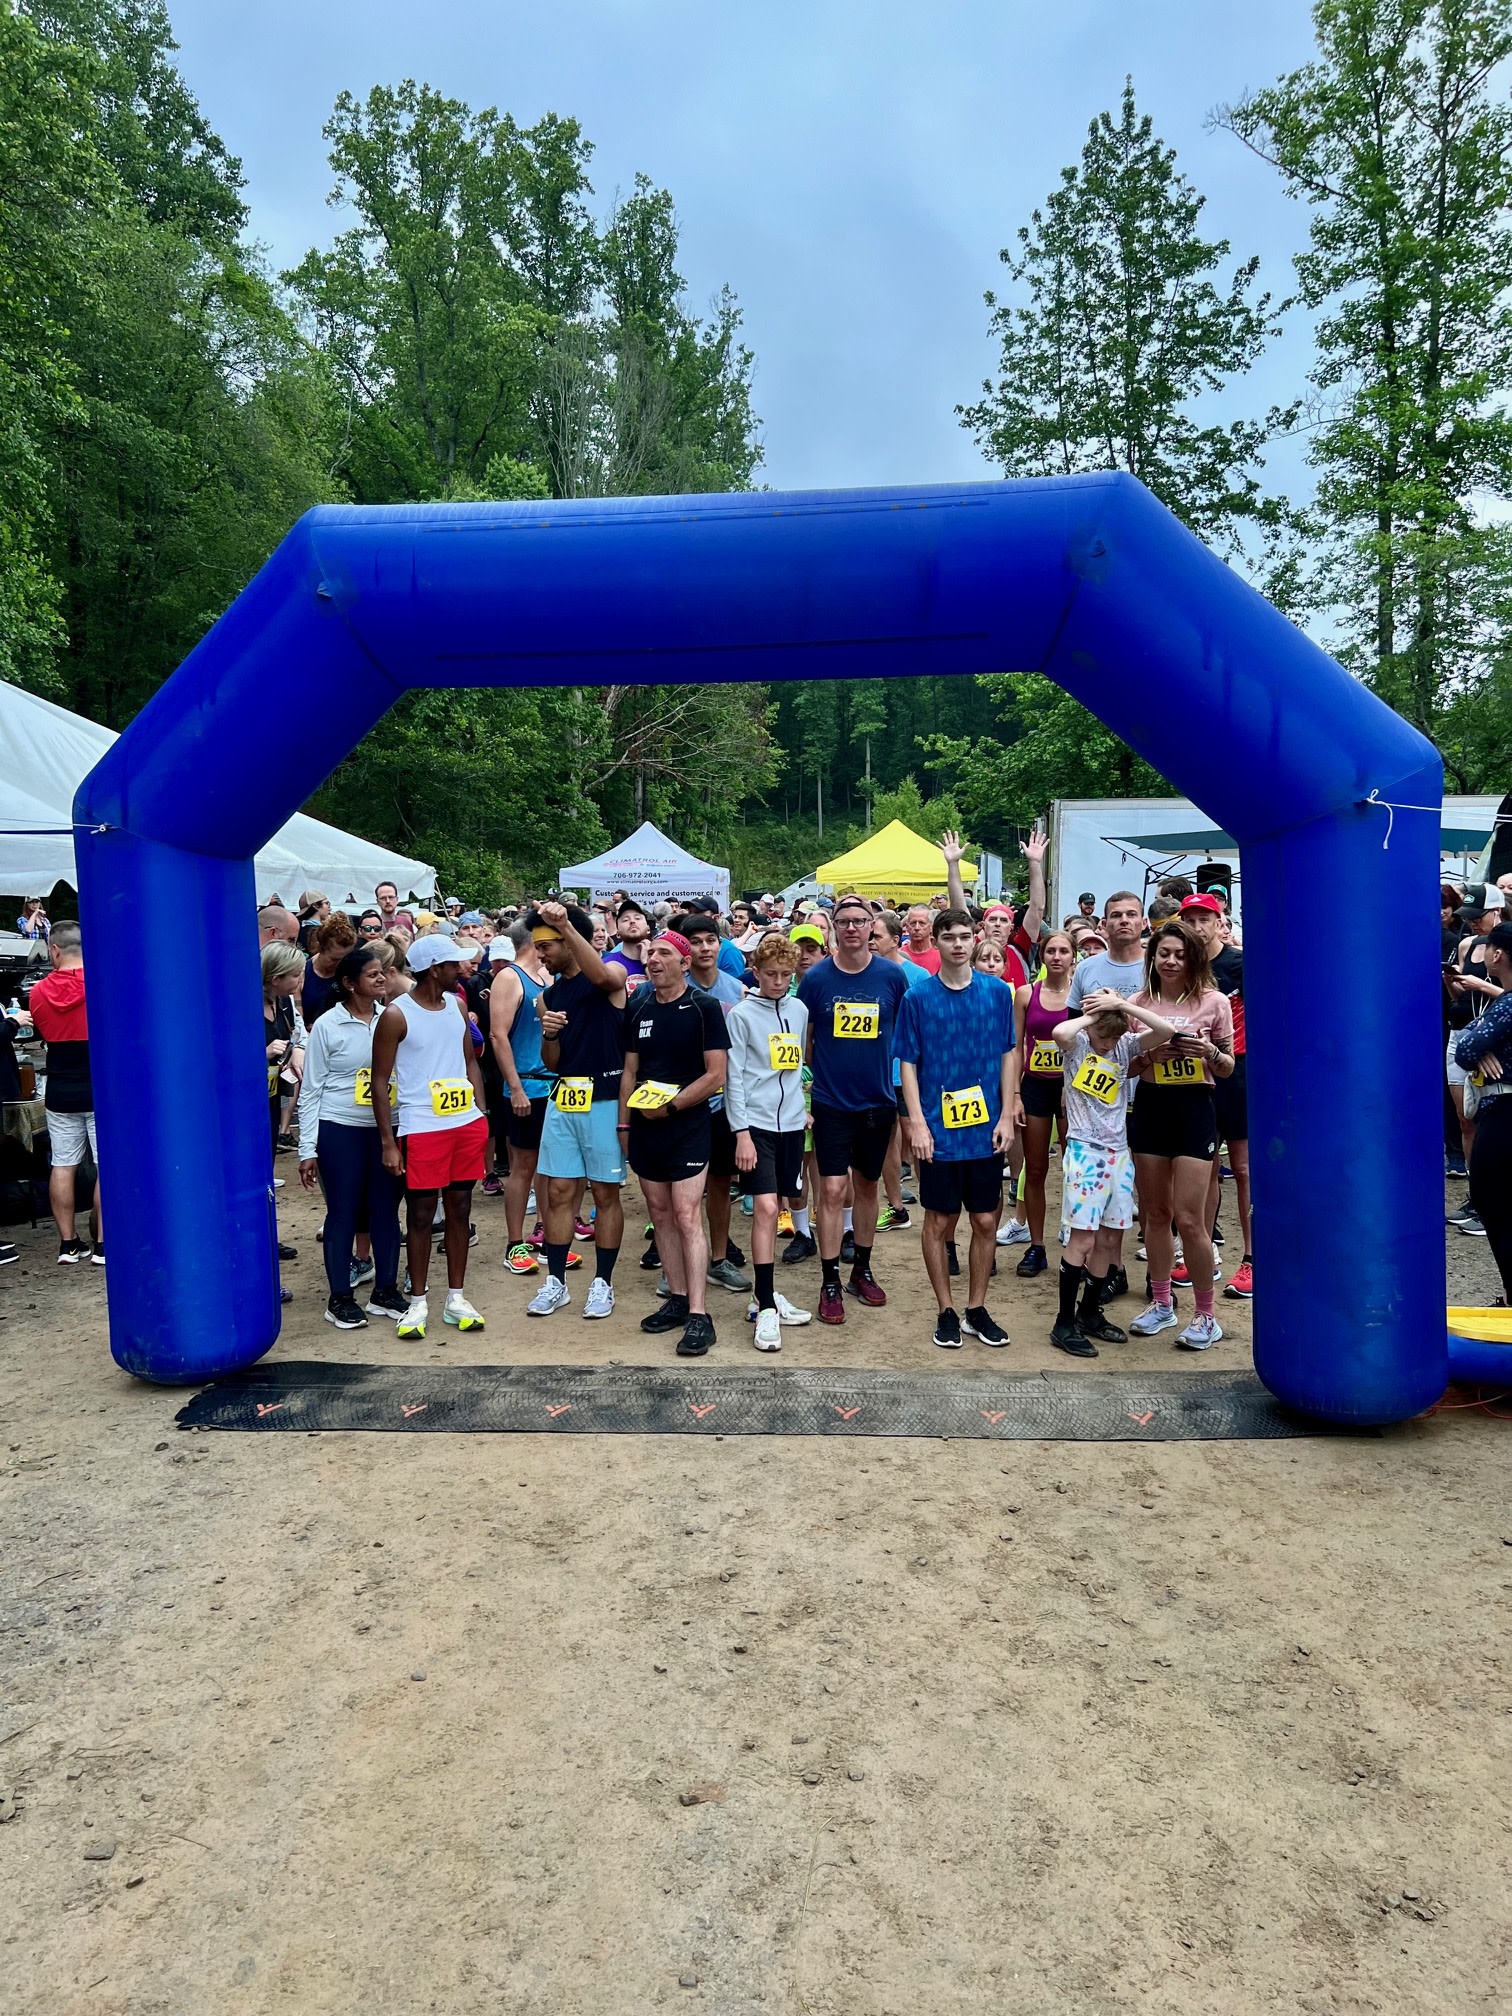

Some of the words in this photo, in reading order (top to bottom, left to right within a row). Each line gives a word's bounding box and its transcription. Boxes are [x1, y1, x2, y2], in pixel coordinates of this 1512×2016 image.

[656, 889, 670, 897] and
[671, 889, 704, 897] customer
[840, 1015, 872, 1033] 228
[777, 1046, 800, 1064] 229
[1034, 1051, 1063, 1067] 230
[1161, 1058, 1195, 1078] 196
[1082, 1069, 1117, 1095] 197
[440, 1089, 468, 1110] 251
[560, 1089, 587, 1107] 183
[635, 1089, 671, 1105] 275
[950, 1100, 982, 1122] 173
